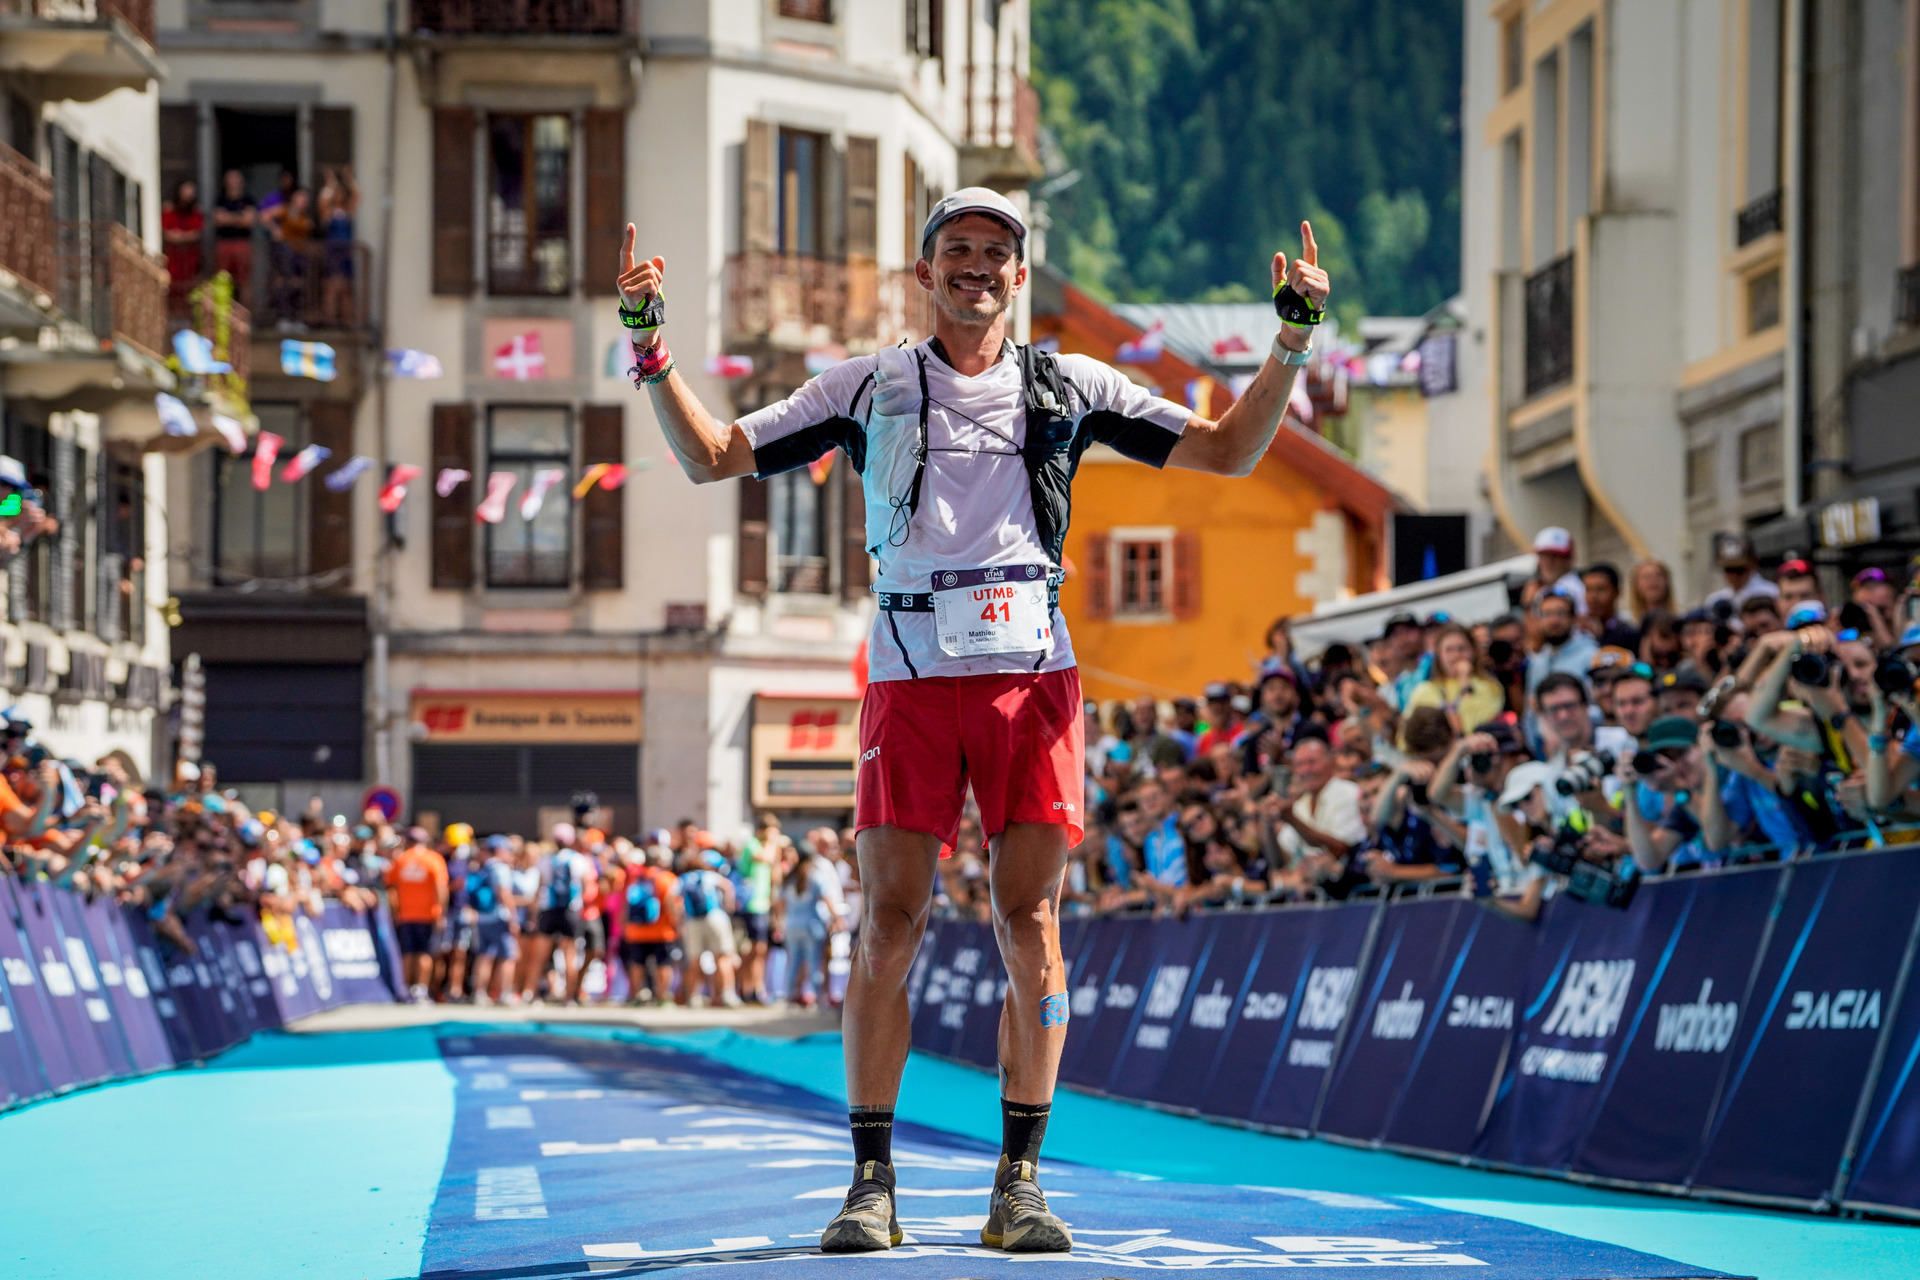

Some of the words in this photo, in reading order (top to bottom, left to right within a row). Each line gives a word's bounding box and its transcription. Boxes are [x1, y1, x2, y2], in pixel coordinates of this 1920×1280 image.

[620, 314, 649, 326] LEKI
[984, 570, 1004, 578] UTMB
[973, 587, 1014, 602] UTMB
[980, 602, 1010, 622] 41
[968, 630, 996, 638] Mathieu
[1785, 989, 1881, 1030] DACIA
